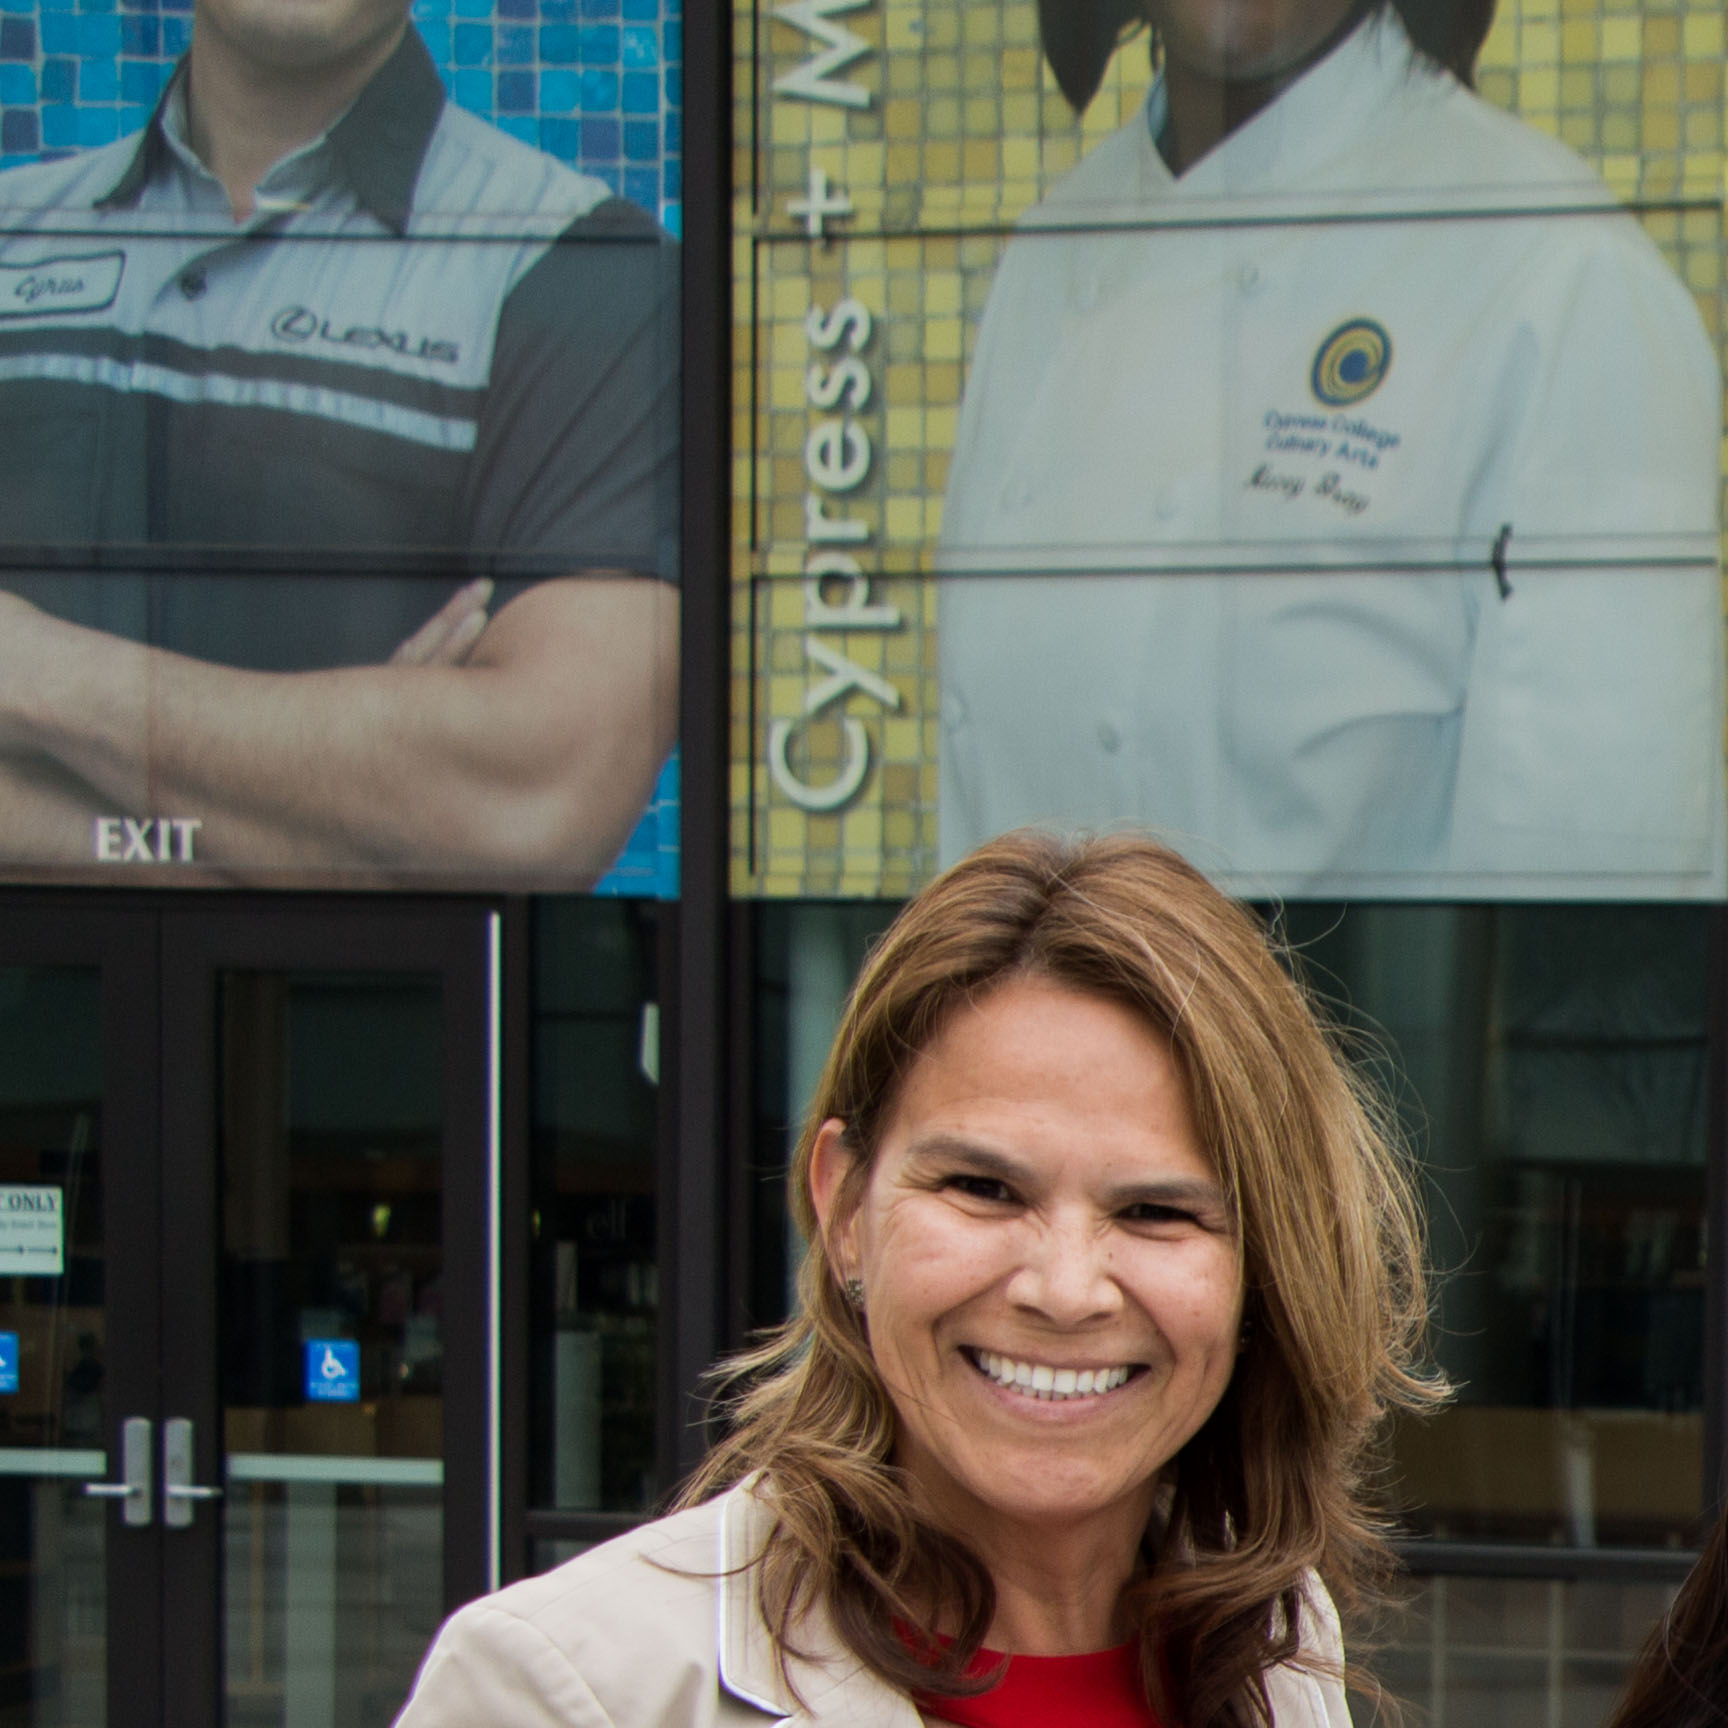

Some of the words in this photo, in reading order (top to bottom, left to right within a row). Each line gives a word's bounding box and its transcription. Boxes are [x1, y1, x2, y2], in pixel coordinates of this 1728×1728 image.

[320, 319, 459, 364] LEXUS
[1264, 409, 1327, 431] Cypress
[1330, 413, 1401, 450] College
[1335, 441, 1379, 469] Arts
[769, 299, 899, 810] Cypress
[94, 817, 203, 863] EXIT
